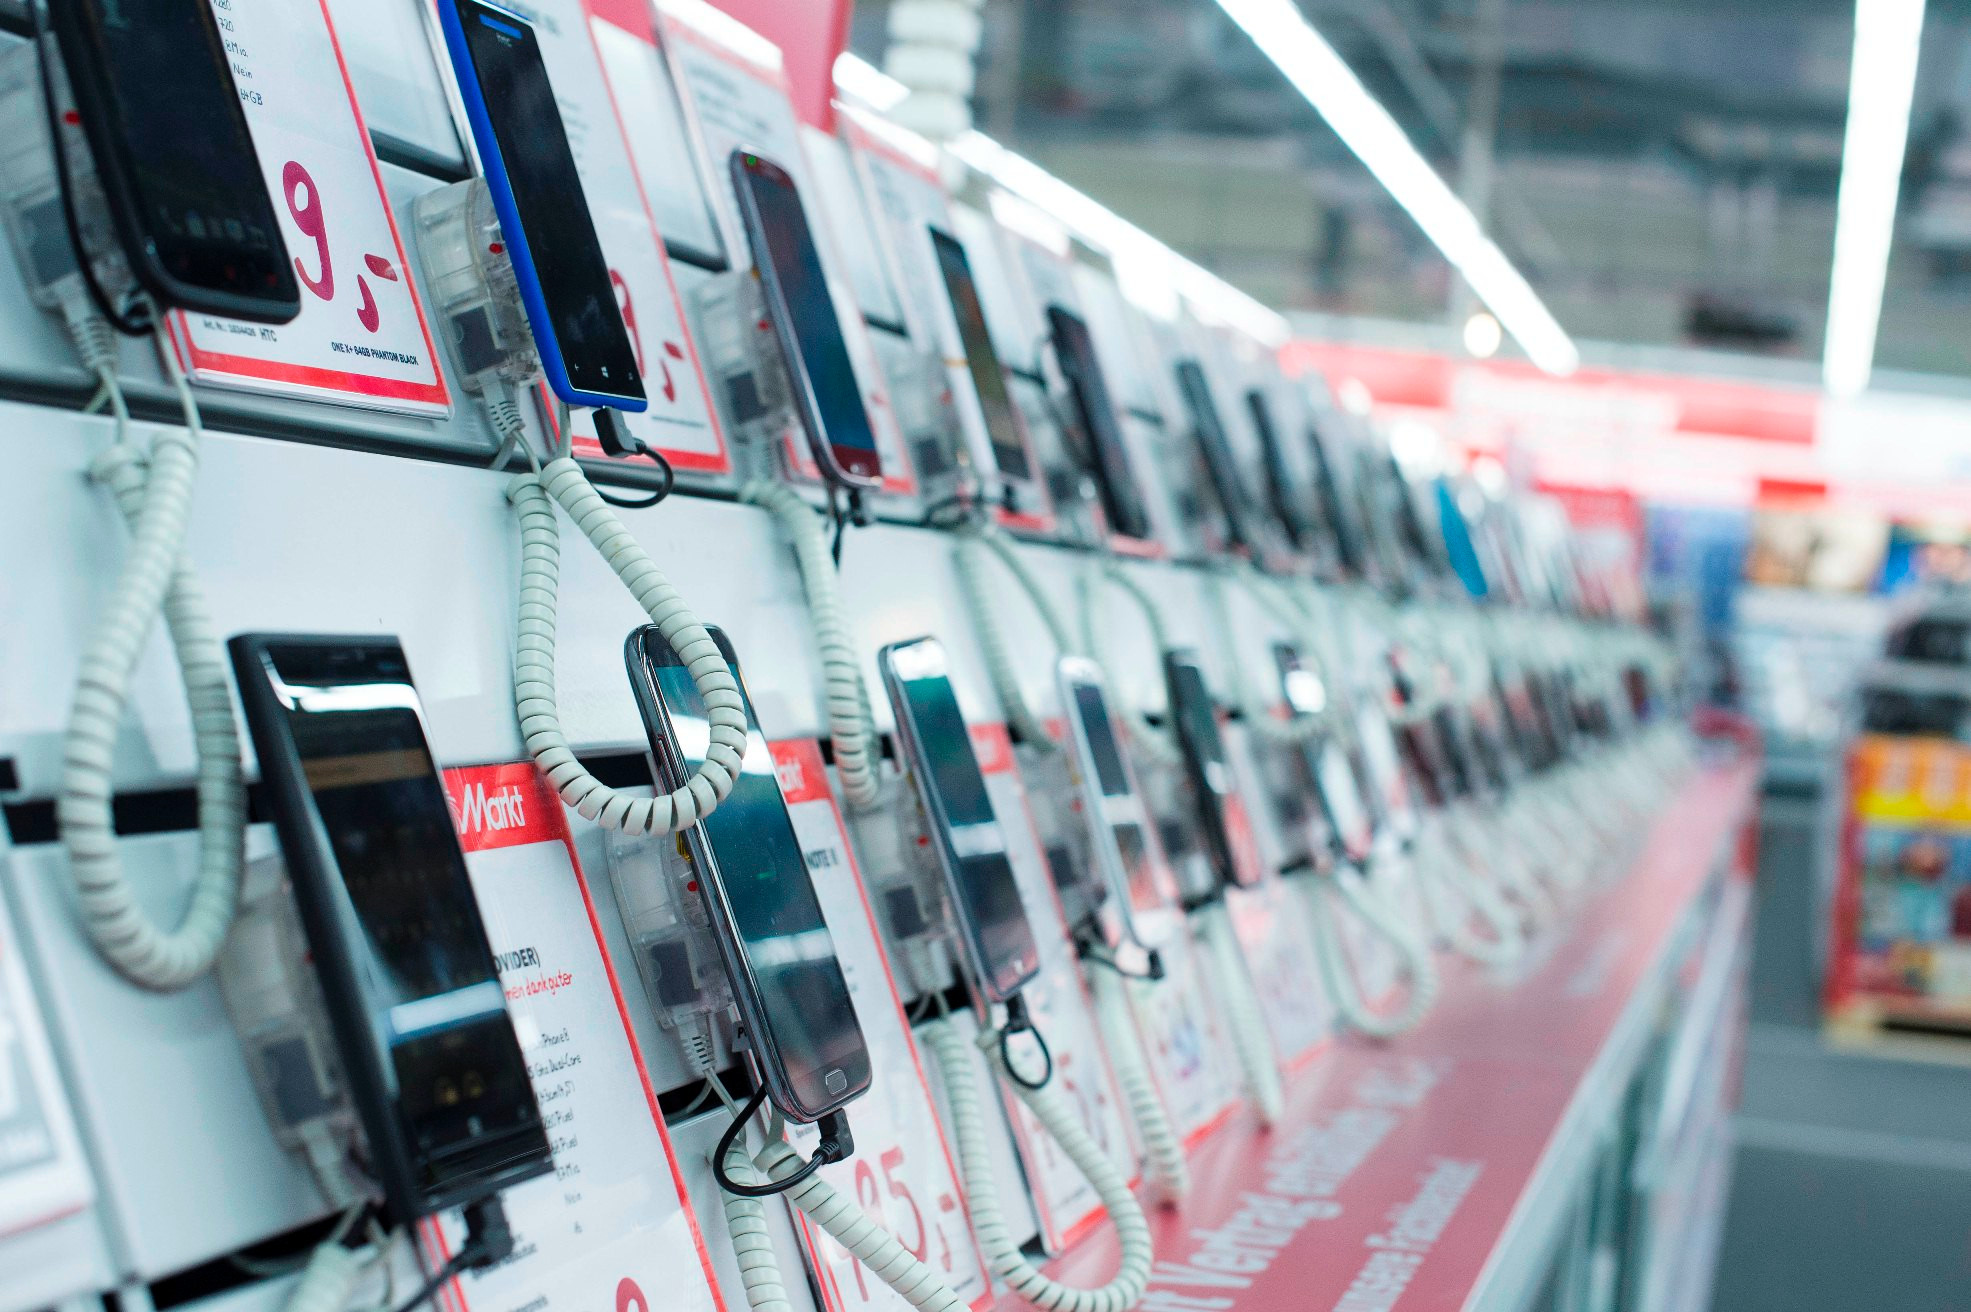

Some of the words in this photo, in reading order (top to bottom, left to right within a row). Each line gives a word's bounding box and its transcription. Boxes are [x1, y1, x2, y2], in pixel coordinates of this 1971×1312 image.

[233, 62, 253, 79] Nein
[259, 328, 277, 343] HTC
[331, 341, 345, 353] ONE
[344, 344, 353, 354] X+
[370, 348, 400, 363] PHANTOM
[399, 353, 419, 366] BLACK
[460, 782, 527, 835] Markt
